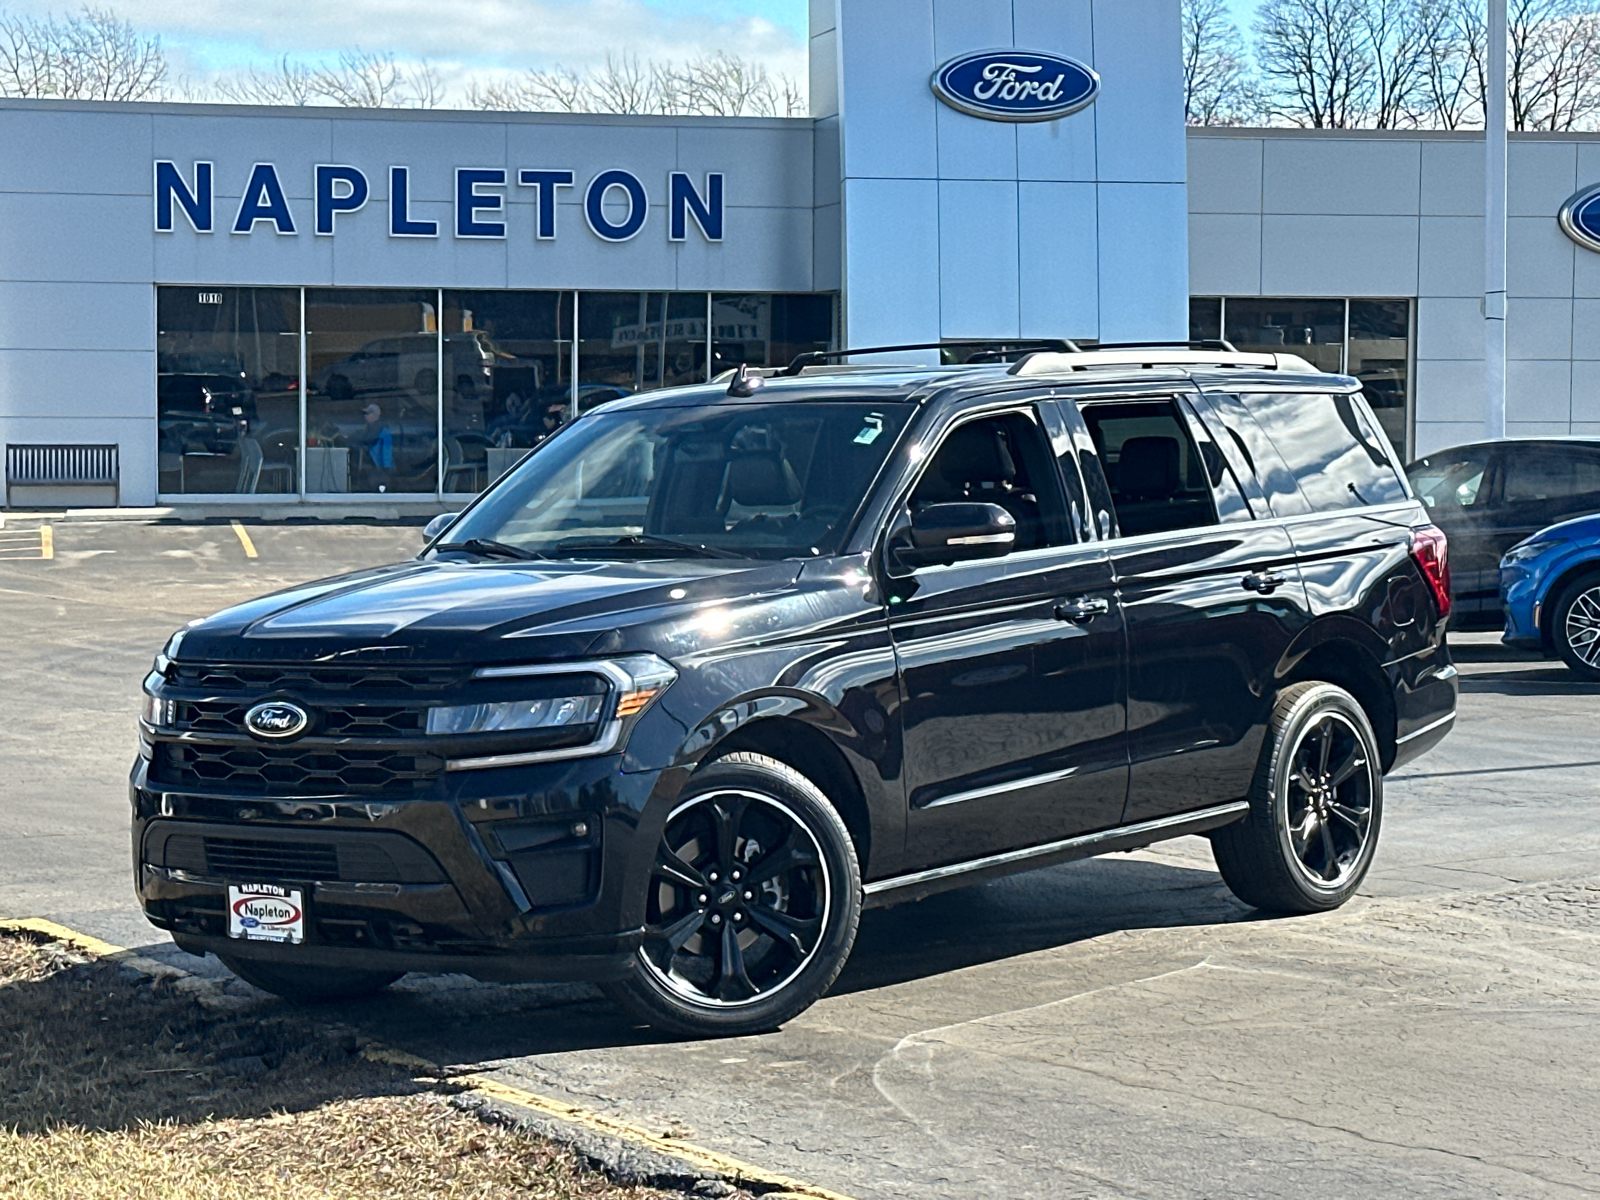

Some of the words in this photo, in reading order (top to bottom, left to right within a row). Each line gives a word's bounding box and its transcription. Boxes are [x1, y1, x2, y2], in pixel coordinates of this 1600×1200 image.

[973, 62, 1065, 101] Ford
[153, 159, 724, 243] NAPLETON
[199, 292, 222, 304] 1010
[257, 708, 291, 728] Ford
[241, 884, 285, 896] NAPLETON
[244, 902, 291, 920] Napleton
